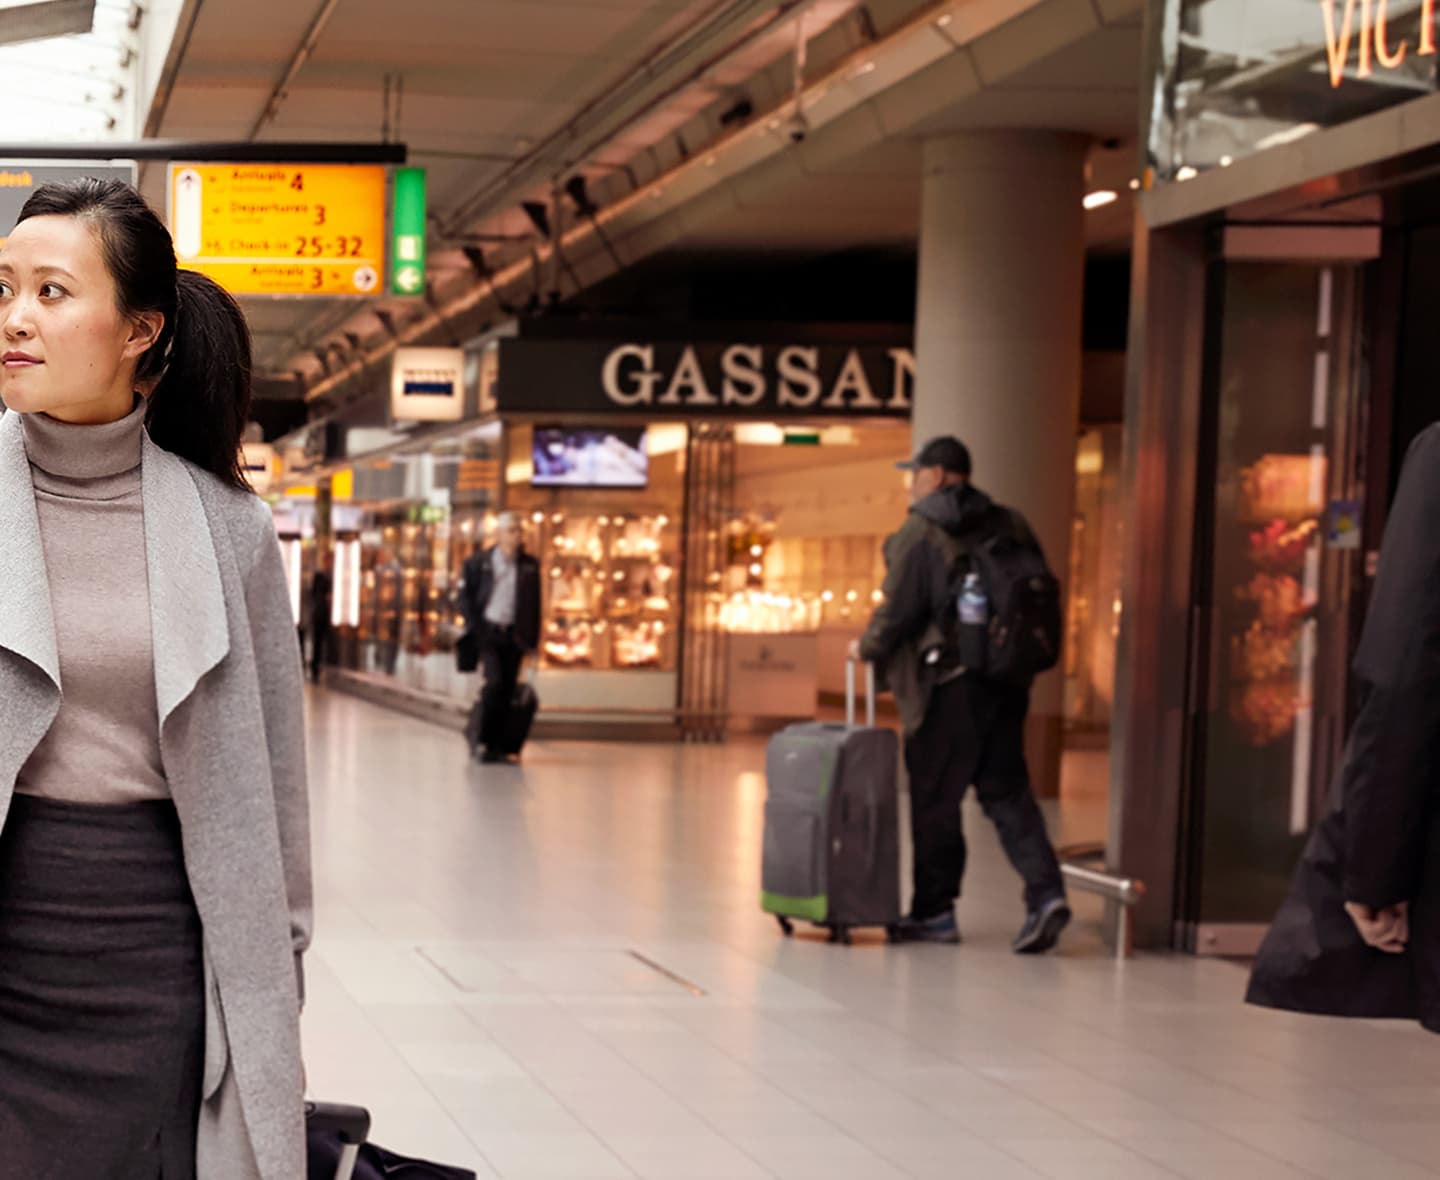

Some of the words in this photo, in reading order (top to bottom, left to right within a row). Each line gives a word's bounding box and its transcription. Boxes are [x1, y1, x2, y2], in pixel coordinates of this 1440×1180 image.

[231, 170, 286, 181] Arrivals
[290, 173, 304, 191] 4
[314, 204, 327, 226] 3
[295, 236, 363, 257] 25-32
[312, 268, 324, 289] 3
